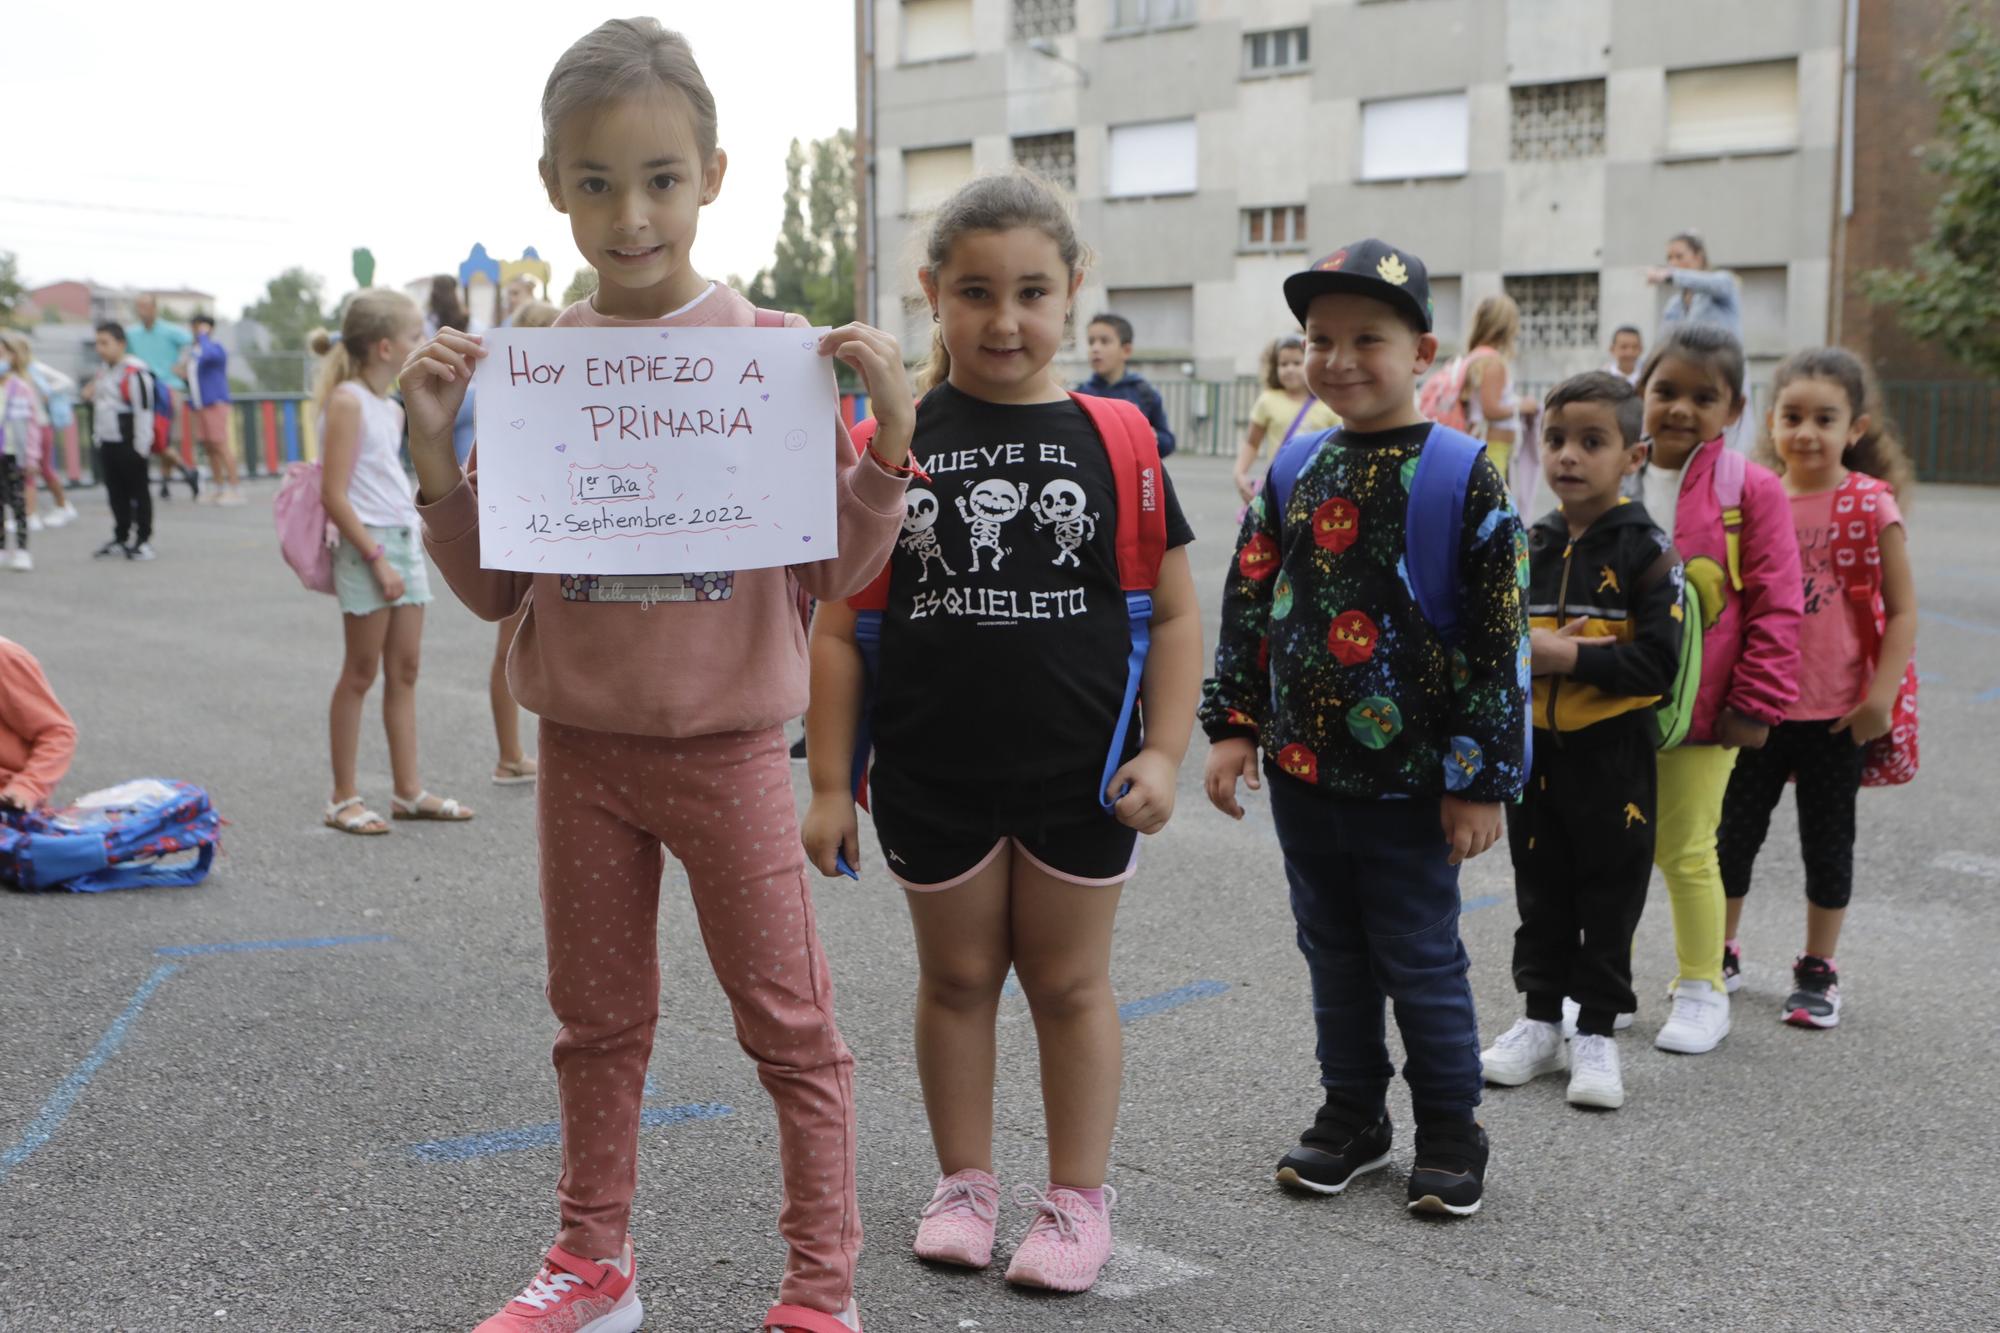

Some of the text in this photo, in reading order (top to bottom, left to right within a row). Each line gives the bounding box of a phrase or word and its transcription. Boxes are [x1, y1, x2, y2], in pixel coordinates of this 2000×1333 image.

[739, 359, 765, 385] A
[907, 443, 1077, 475] MUEVE EL
[910, 586, 1088, 620] ESQUELETO
